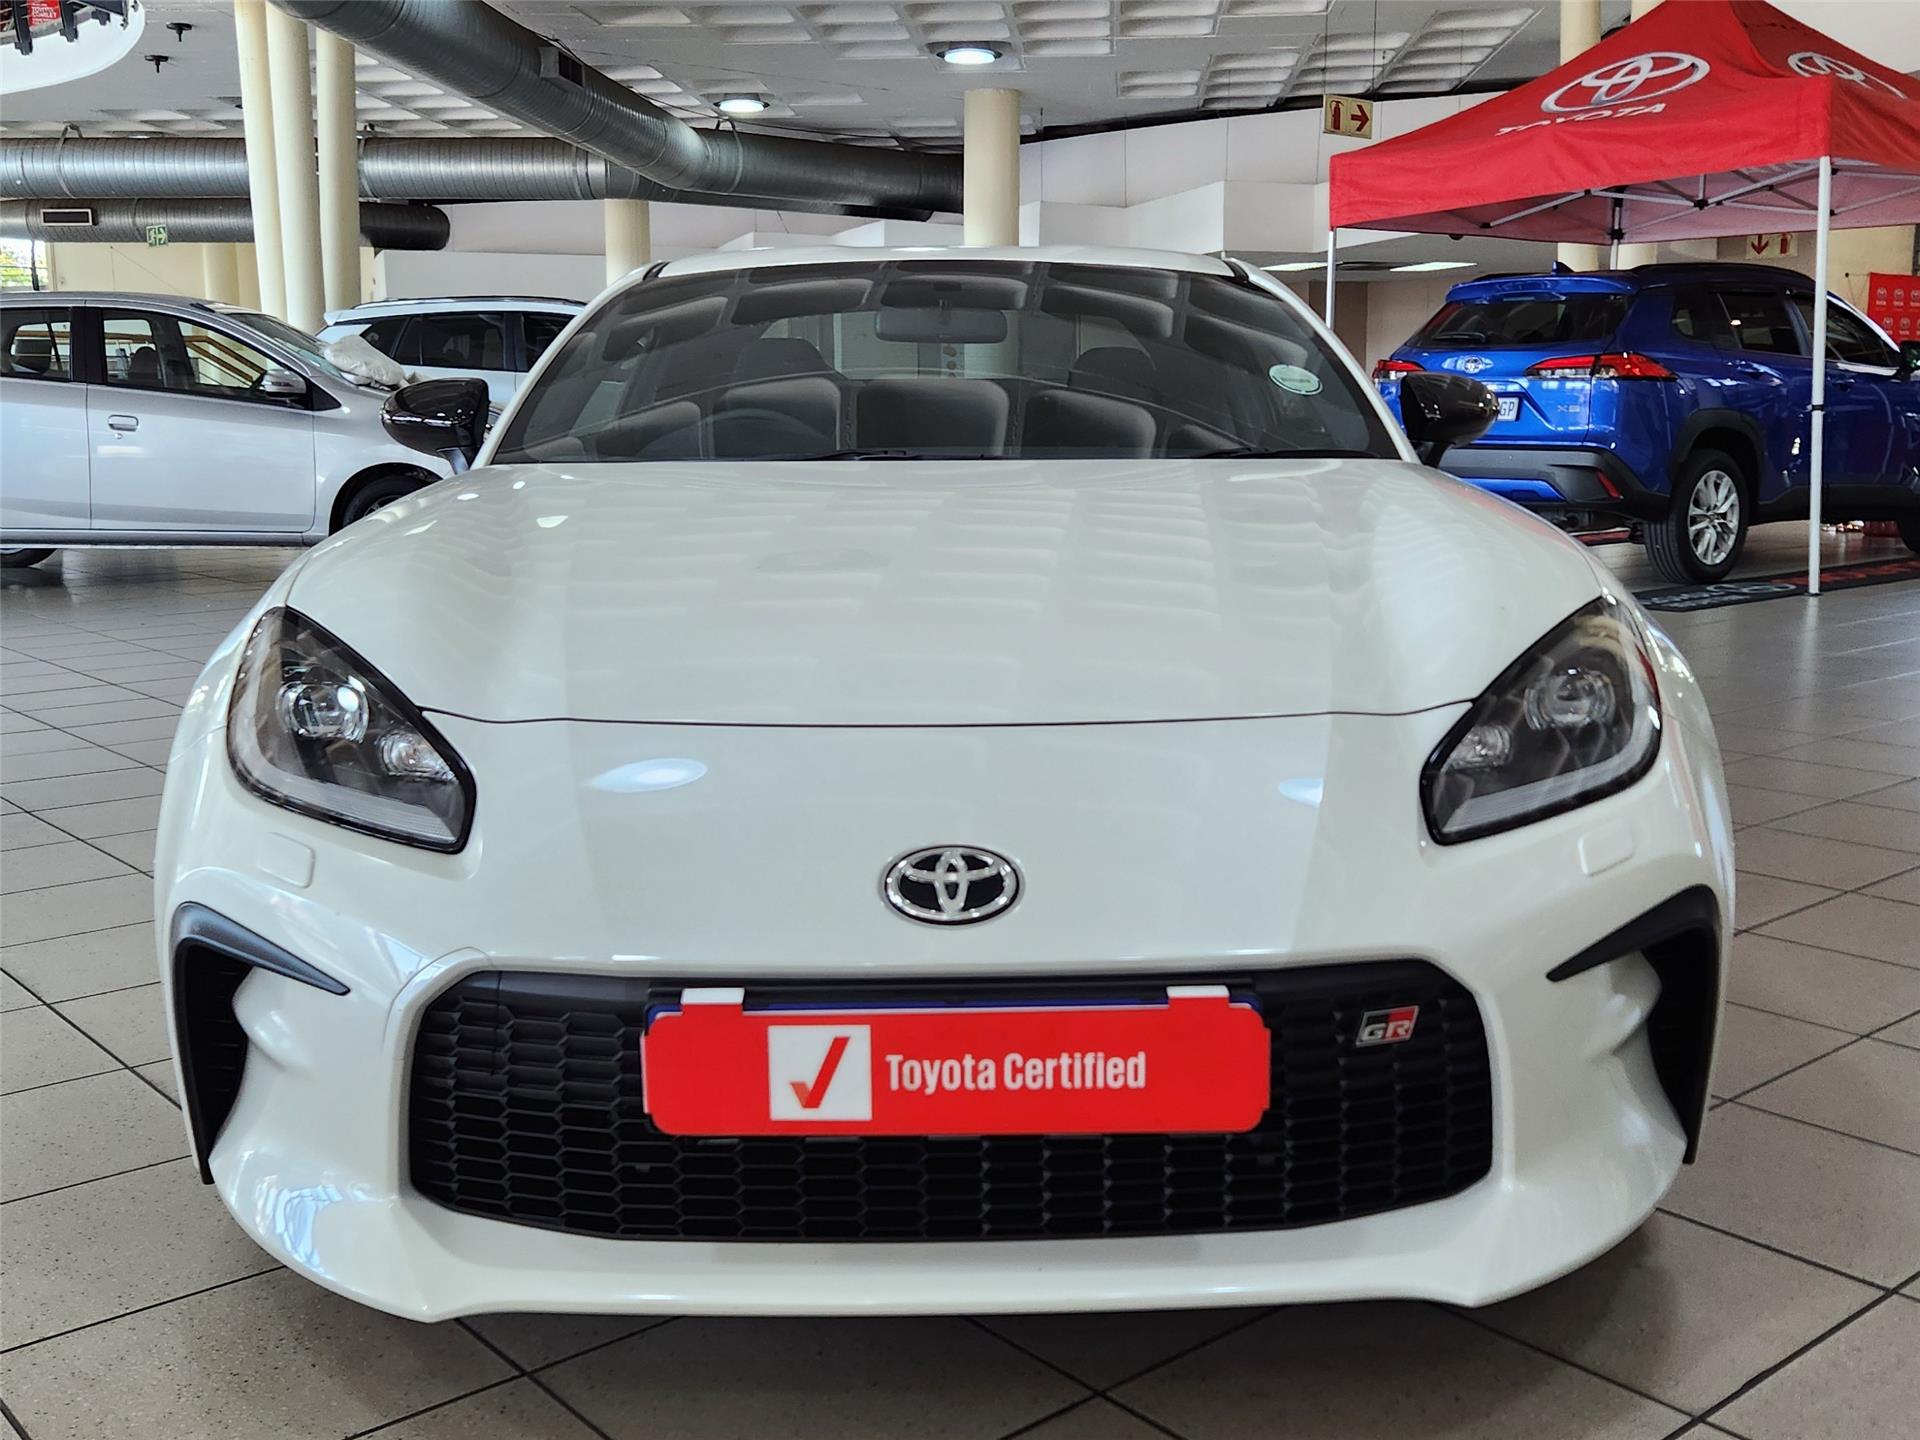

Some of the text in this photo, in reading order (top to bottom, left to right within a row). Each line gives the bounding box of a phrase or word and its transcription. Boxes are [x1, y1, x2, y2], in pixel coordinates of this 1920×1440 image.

[1500, 401, 1515, 416] GP
[1360, 1020, 1411, 1041] GR
[885, 1051, 1146, 1095] Toyota Certified
